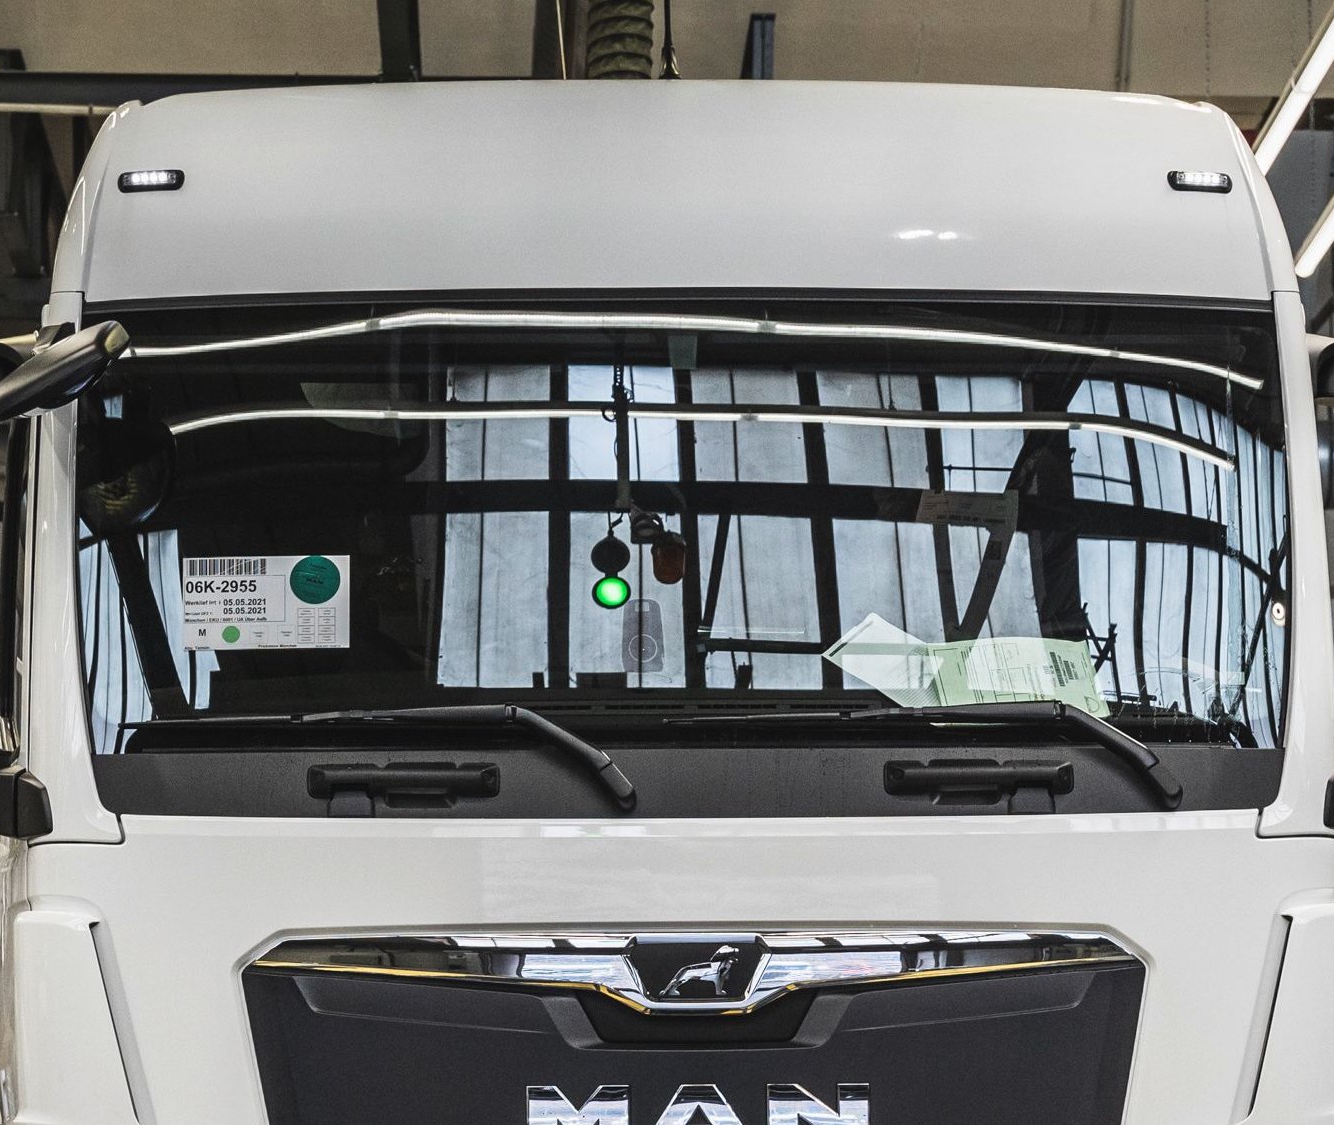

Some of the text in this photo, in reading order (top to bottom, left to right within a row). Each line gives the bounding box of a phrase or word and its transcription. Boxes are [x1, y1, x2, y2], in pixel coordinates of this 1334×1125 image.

[185, 580, 257, 594] 06K-2955
[223, 598, 266, 606] 05.05.2021
[223, 607, 266, 615] 05.05.2021
[198, 628, 207, 637] M
